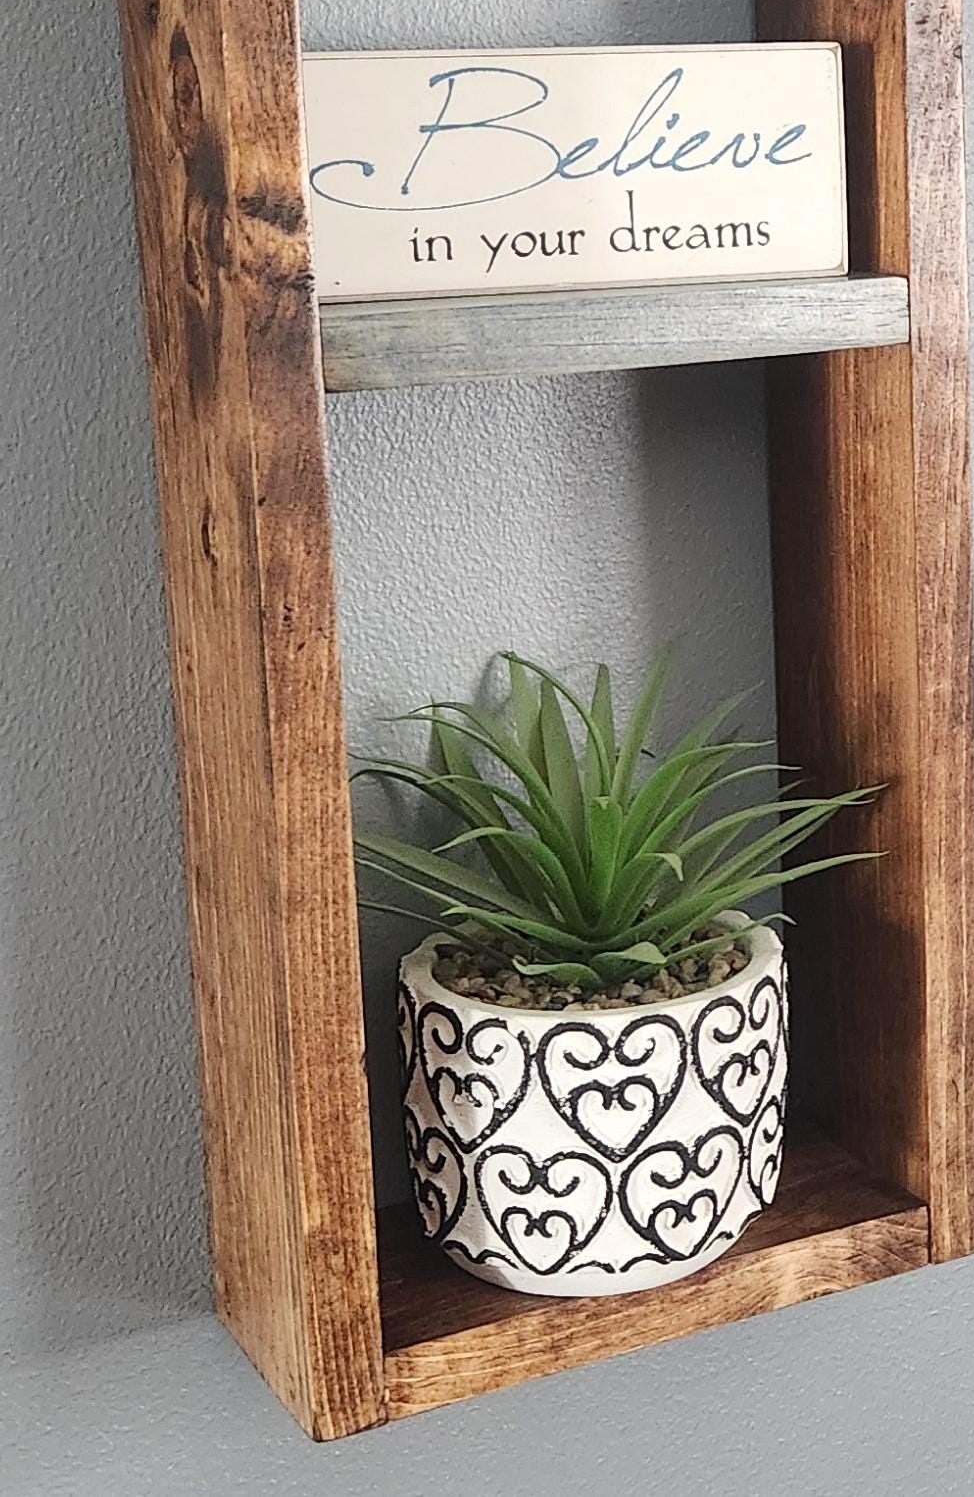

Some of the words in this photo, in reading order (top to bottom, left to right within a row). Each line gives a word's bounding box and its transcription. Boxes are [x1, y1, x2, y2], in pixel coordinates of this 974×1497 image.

[310, 67, 813, 211] Believe
[408, 227, 453, 263] in
[480, 227, 586, 272] your
[609, 190, 771, 254] dreams
